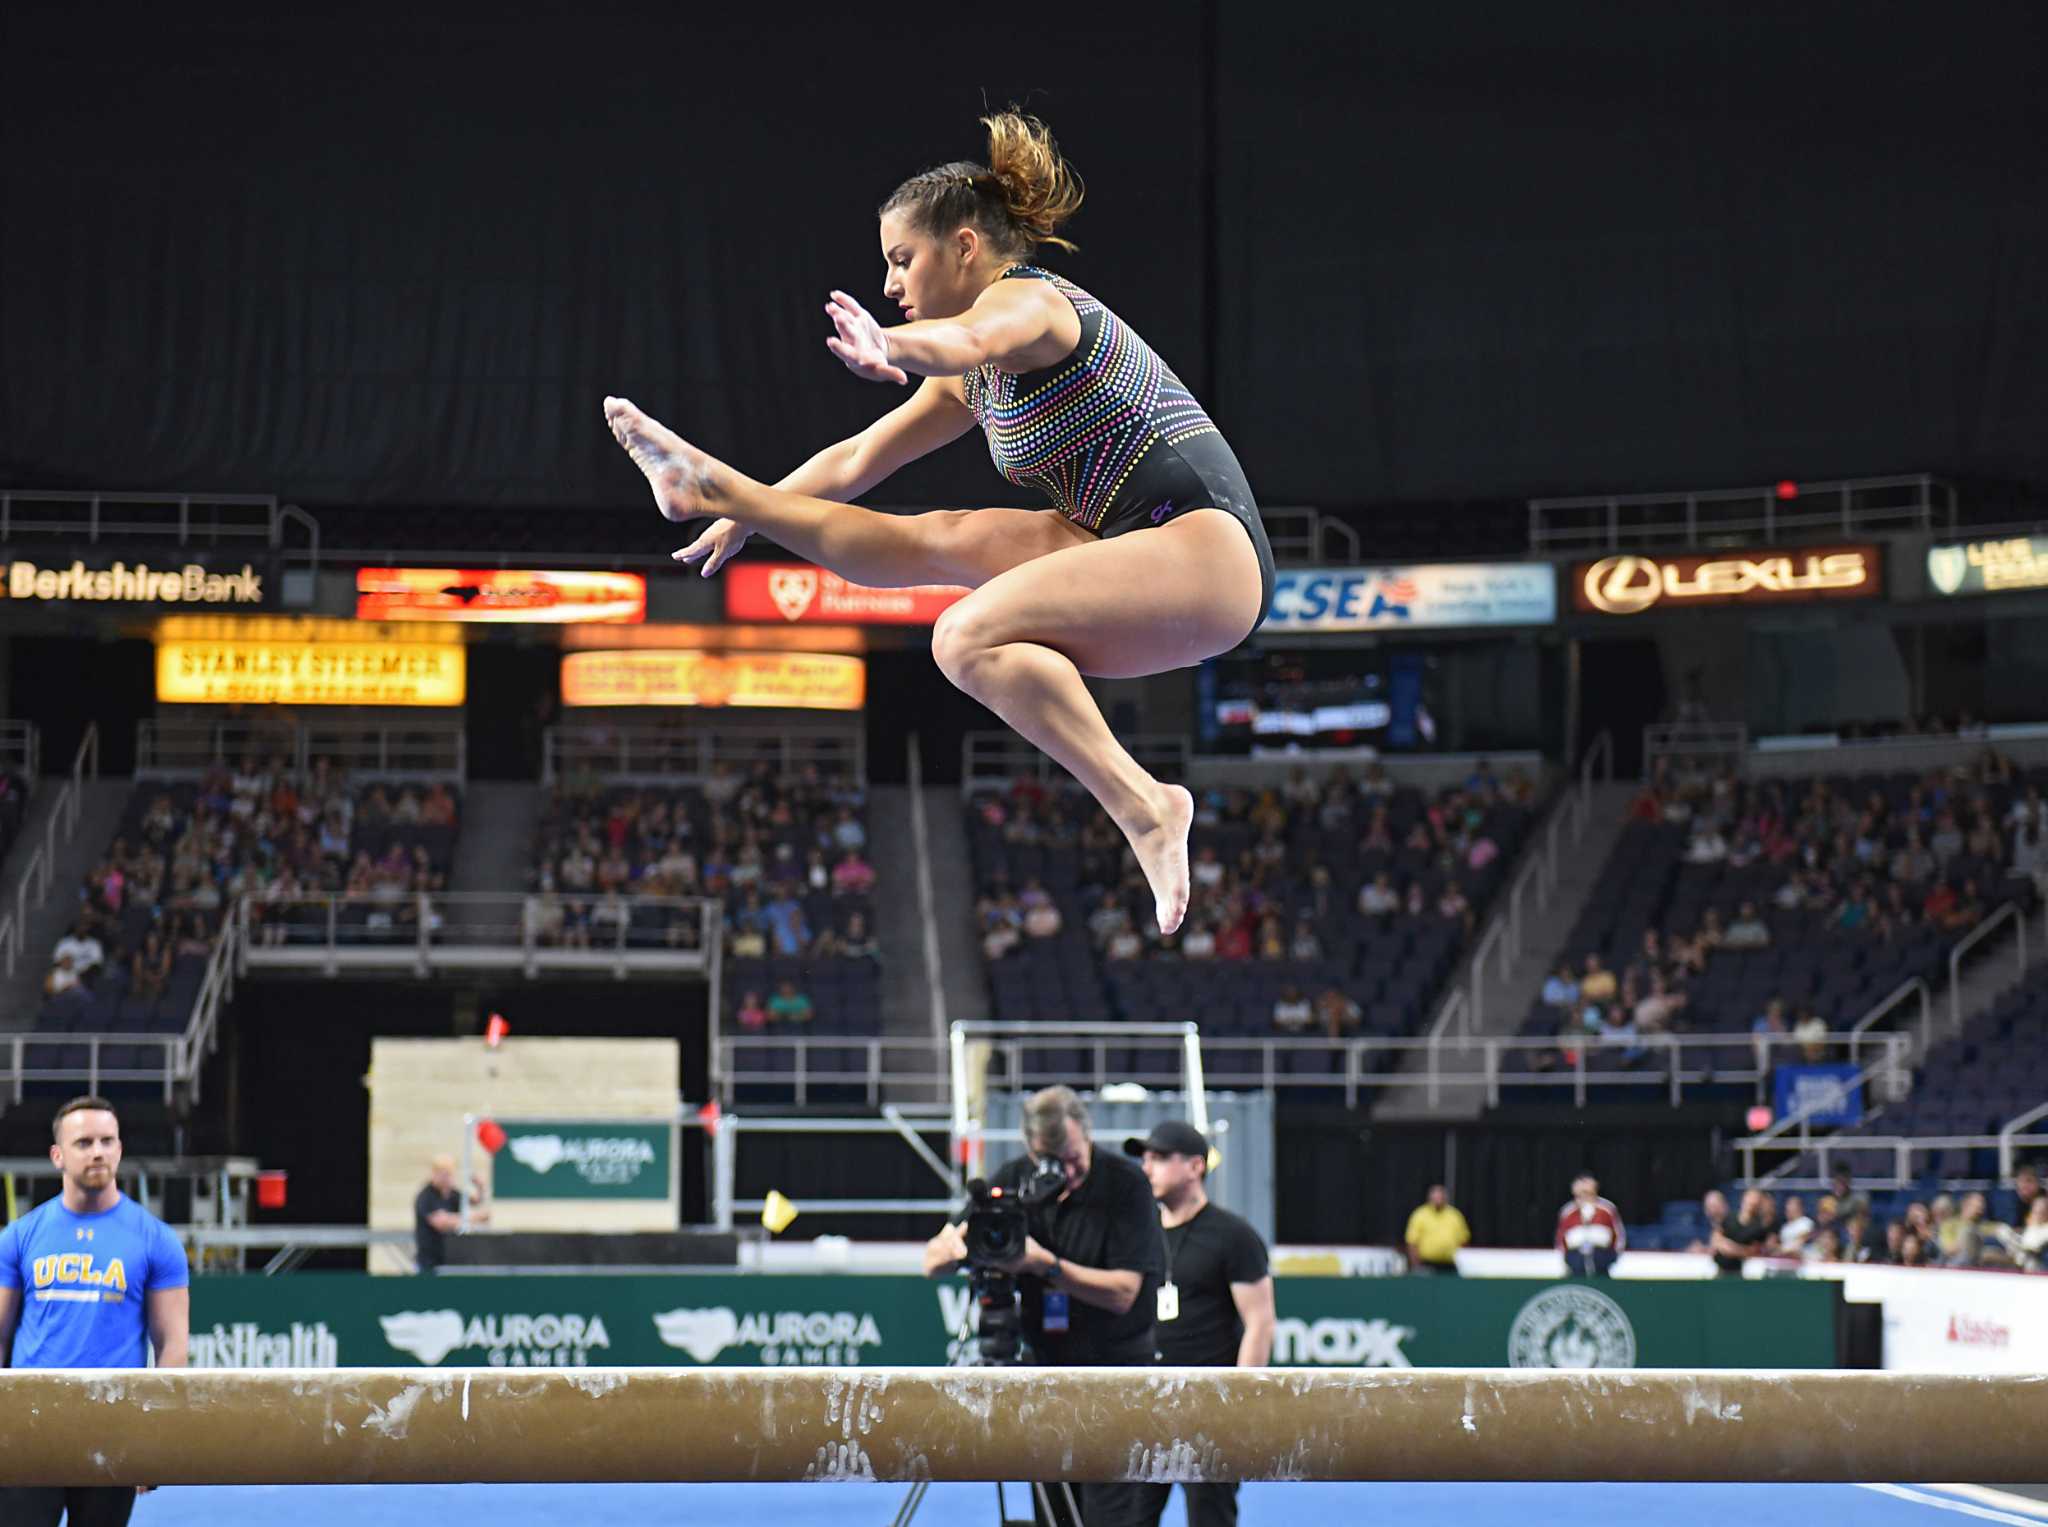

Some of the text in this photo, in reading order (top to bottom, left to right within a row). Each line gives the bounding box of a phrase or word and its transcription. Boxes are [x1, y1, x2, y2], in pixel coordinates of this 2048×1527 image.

[1661, 553, 1866, 597] LEXUS
[1268, 575, 1410, 621] CSEA
[181, 654, 441, 674] STANLEY STEEMER
[33, 1252, 127, 1292] UCLA
[463, 1313, 611, 1350] AURORA
[736, 1310, 883, 1347] AURORA
[487, 1348, 589, 1367] GAMES
[760, 1346, 860, 1366] GAMES
